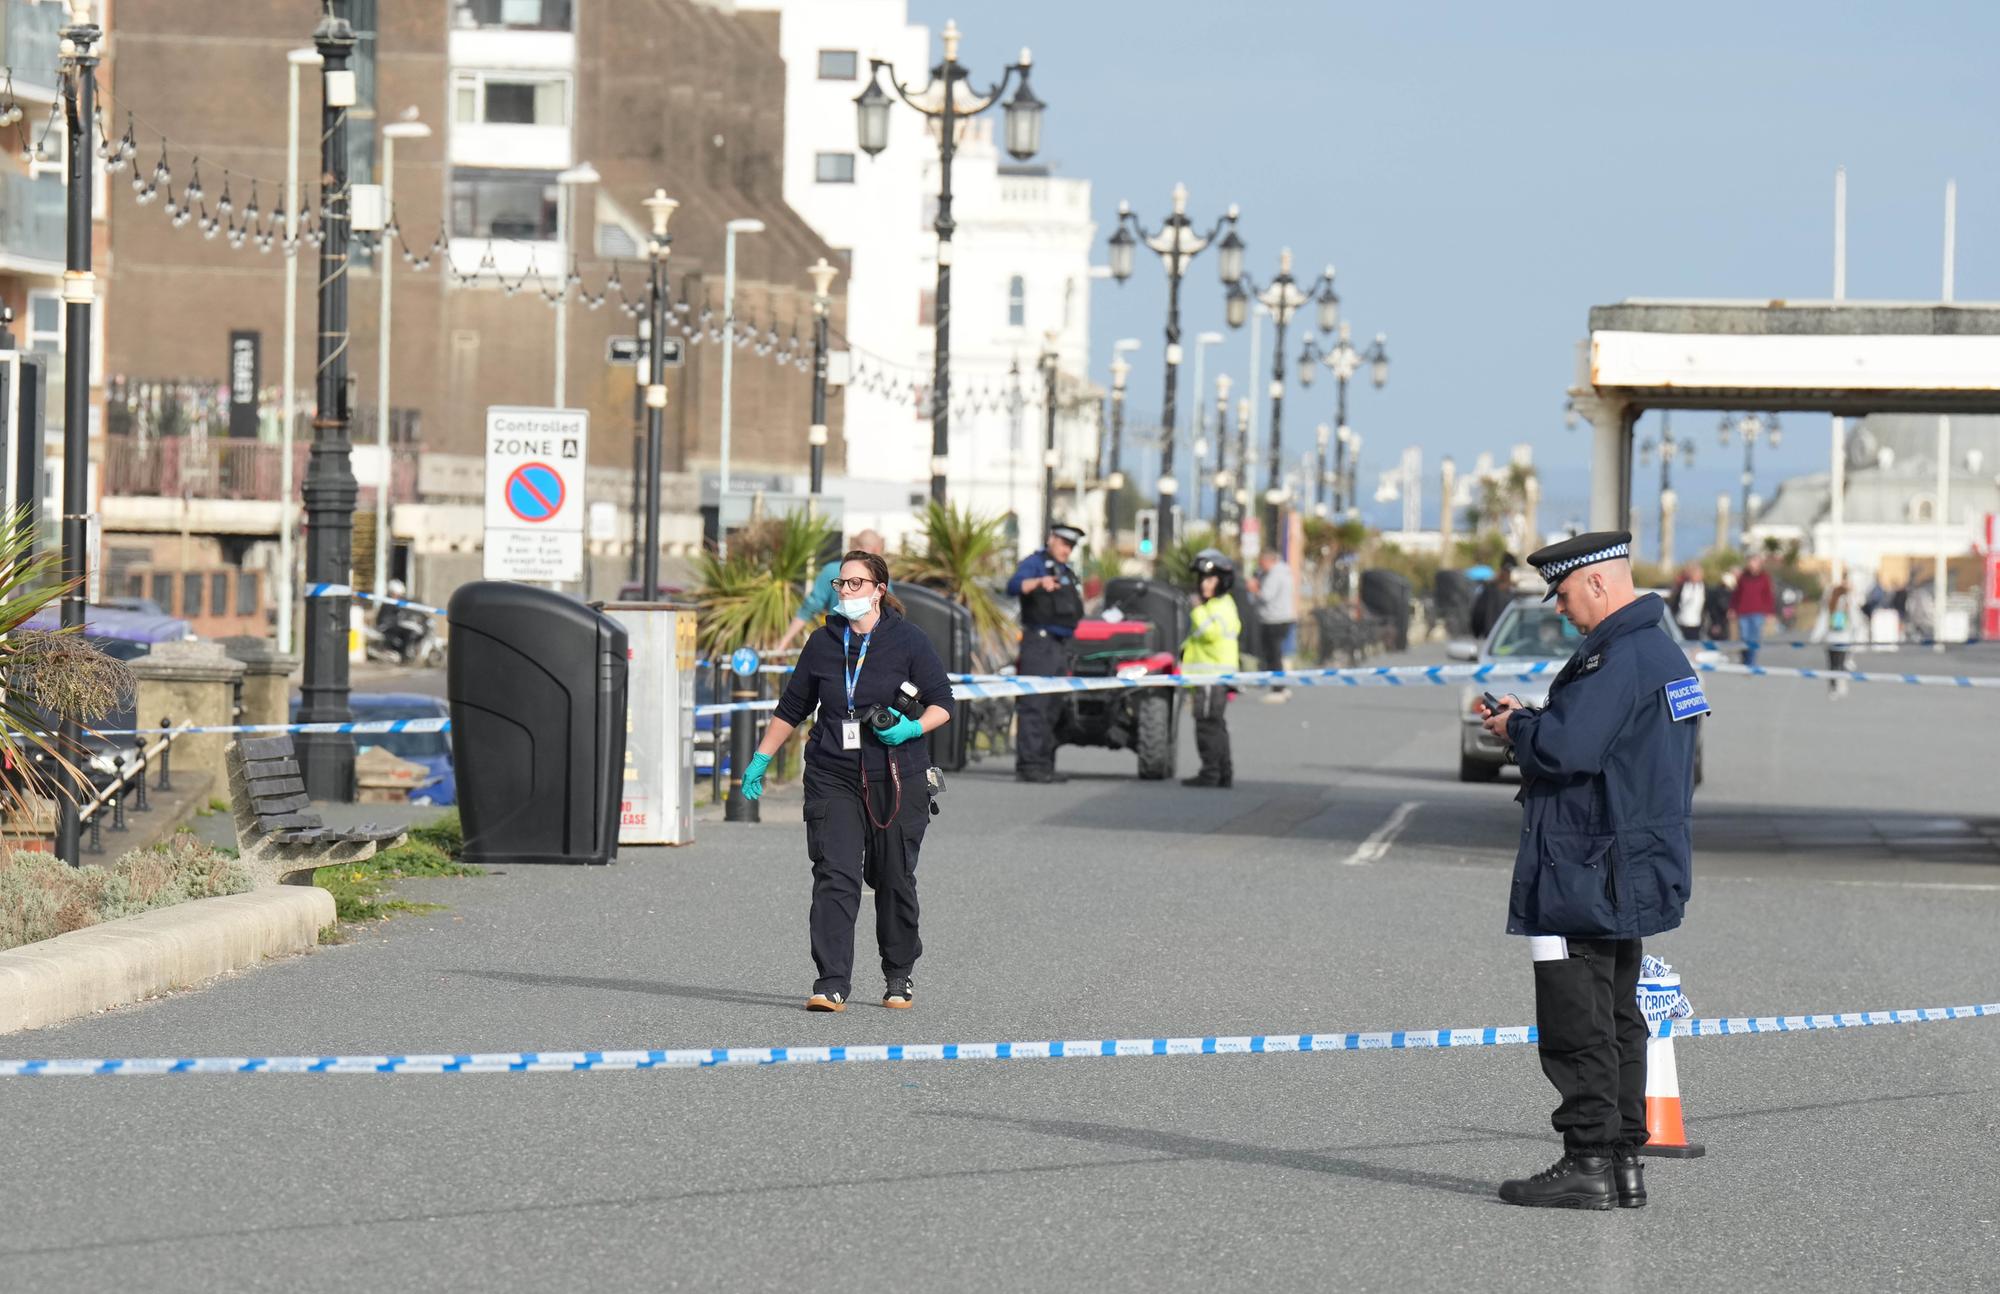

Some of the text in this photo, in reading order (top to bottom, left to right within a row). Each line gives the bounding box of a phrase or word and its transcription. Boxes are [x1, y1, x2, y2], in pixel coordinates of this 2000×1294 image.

[494, 418, 580, 433] Controlled
[494, 439, 577, 457] ZONE A
[1669, 686, 1690, 700] POLICE
[1676, 695, 1704, 711] SUPPORT
